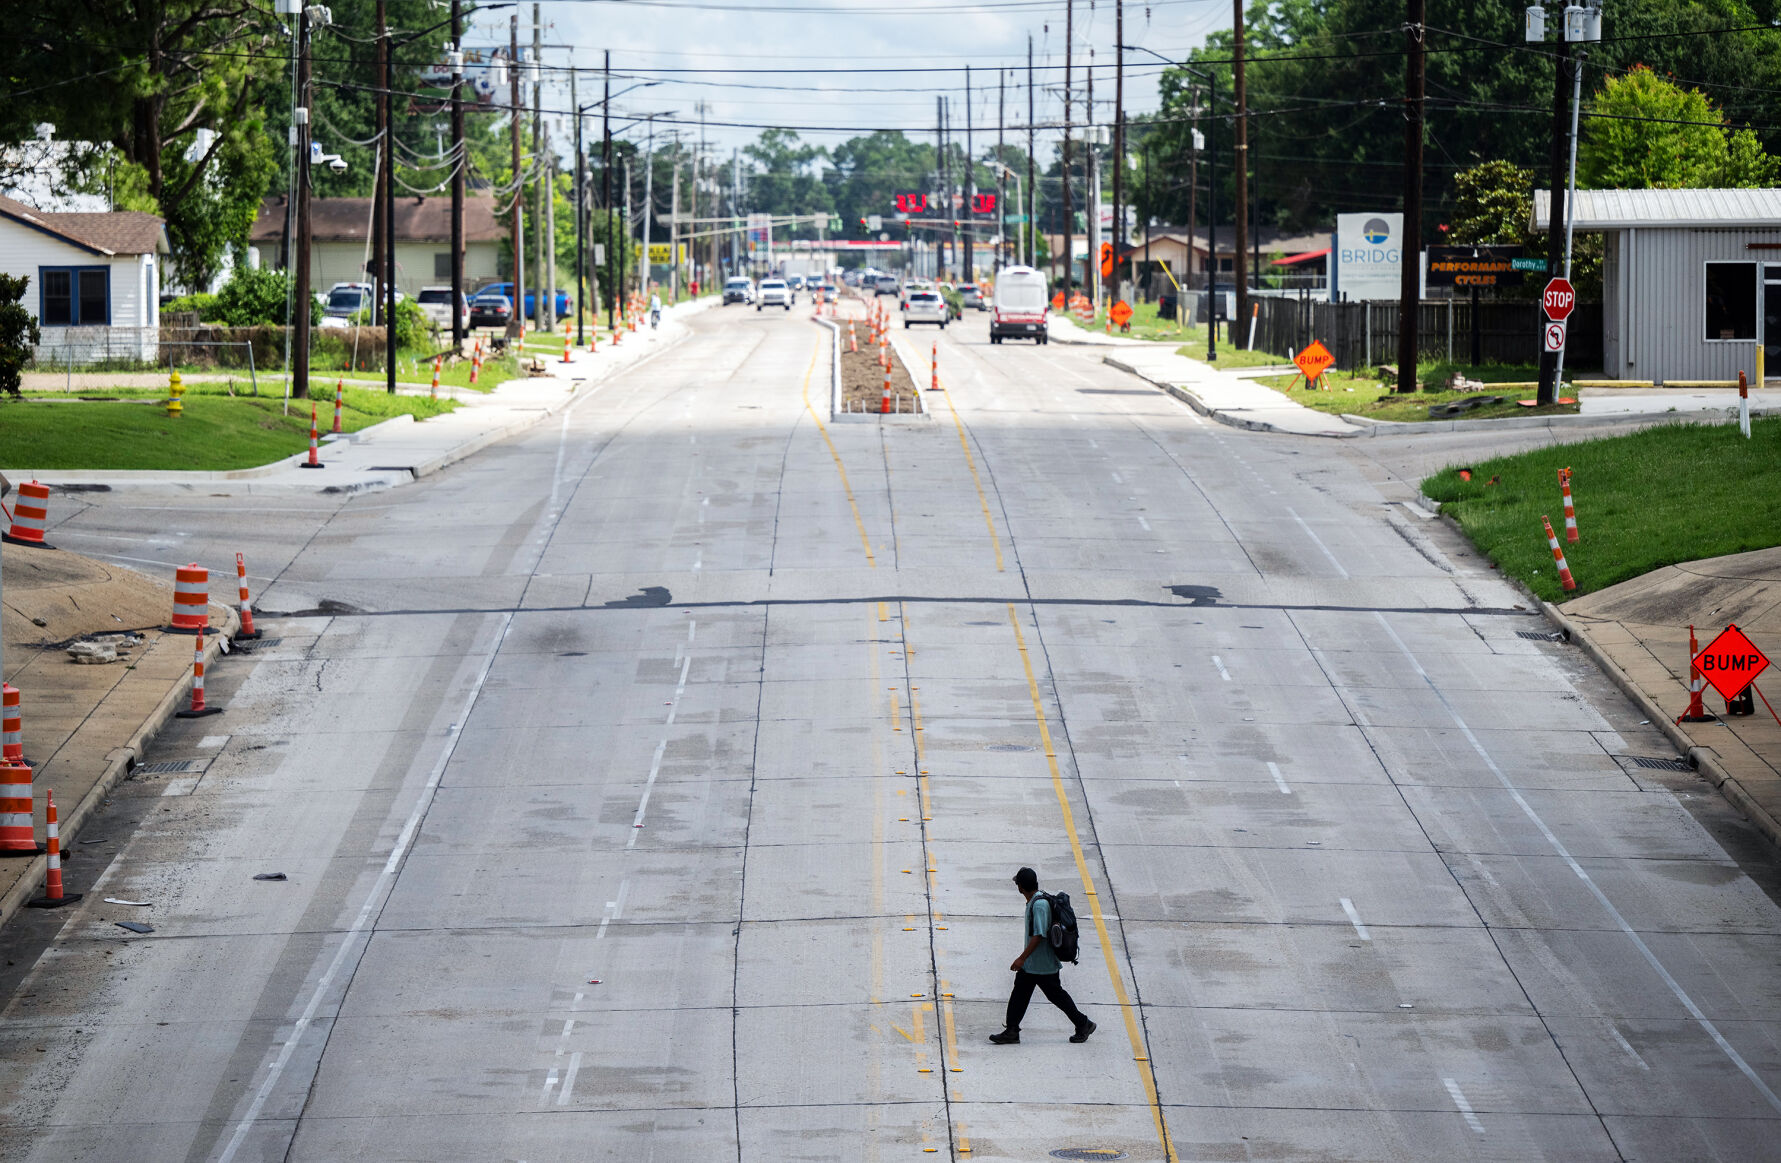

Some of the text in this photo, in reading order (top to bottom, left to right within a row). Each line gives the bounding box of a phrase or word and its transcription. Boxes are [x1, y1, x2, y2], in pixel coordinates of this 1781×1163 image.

[1341, 248, 1402, 263] BRIDG
[1431, 262, 1519, 272] PERFORMANC
[1512, 259, 1536, 269] Dorothy
[1455, 275, 1496, 285] CYCLES
[1545, 290, 1573, 308] STOP
[1300, 355, 1329, 365] BUMP
[1703, 655, 1760, 671] BUMP
